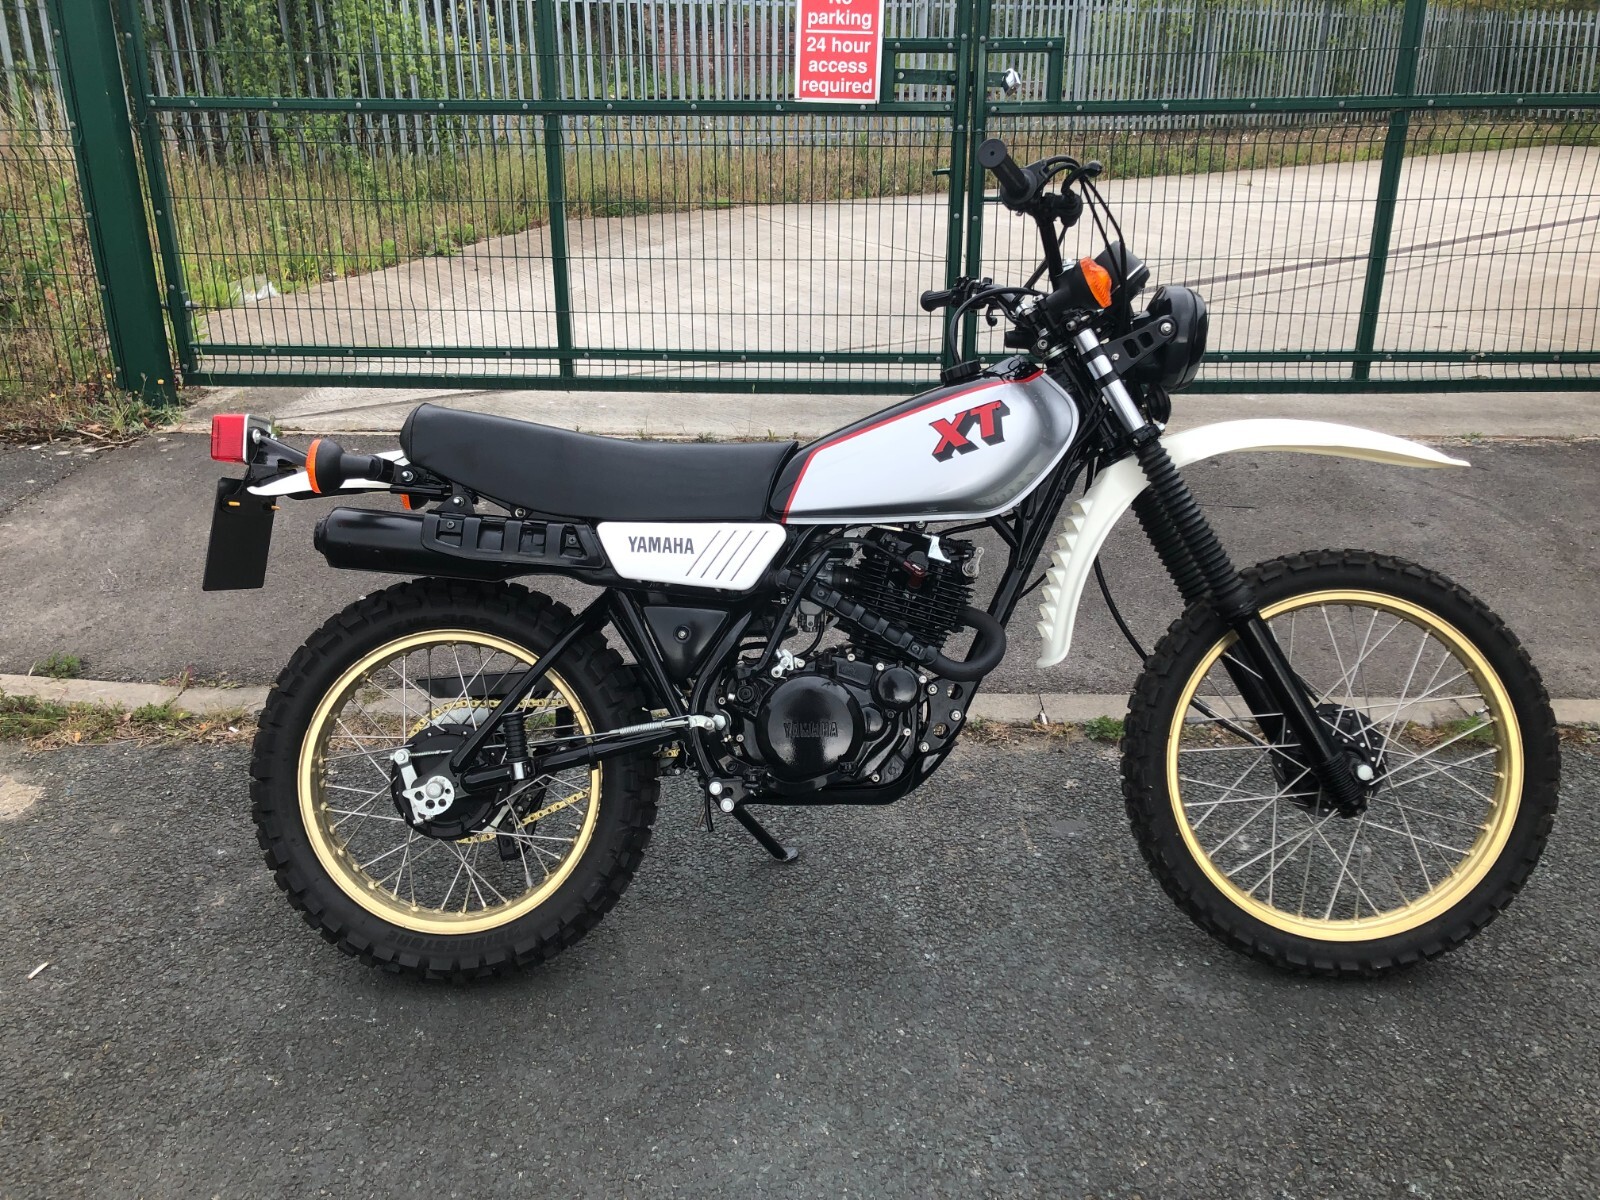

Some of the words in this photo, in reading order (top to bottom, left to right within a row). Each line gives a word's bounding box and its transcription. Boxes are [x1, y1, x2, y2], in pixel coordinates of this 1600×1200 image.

[807, 9, 872, 29] parking
[806, 37, 826, 52] 24
[832, 37, 872, 53] hour
[808, 60, 868, 74] access
[802, 78, 872, 96] required
[929, 400, 1011, 463] XT
[628, 536, 695, 554] YAMAHA
[783, 721, 839, 738] YAMAHA
